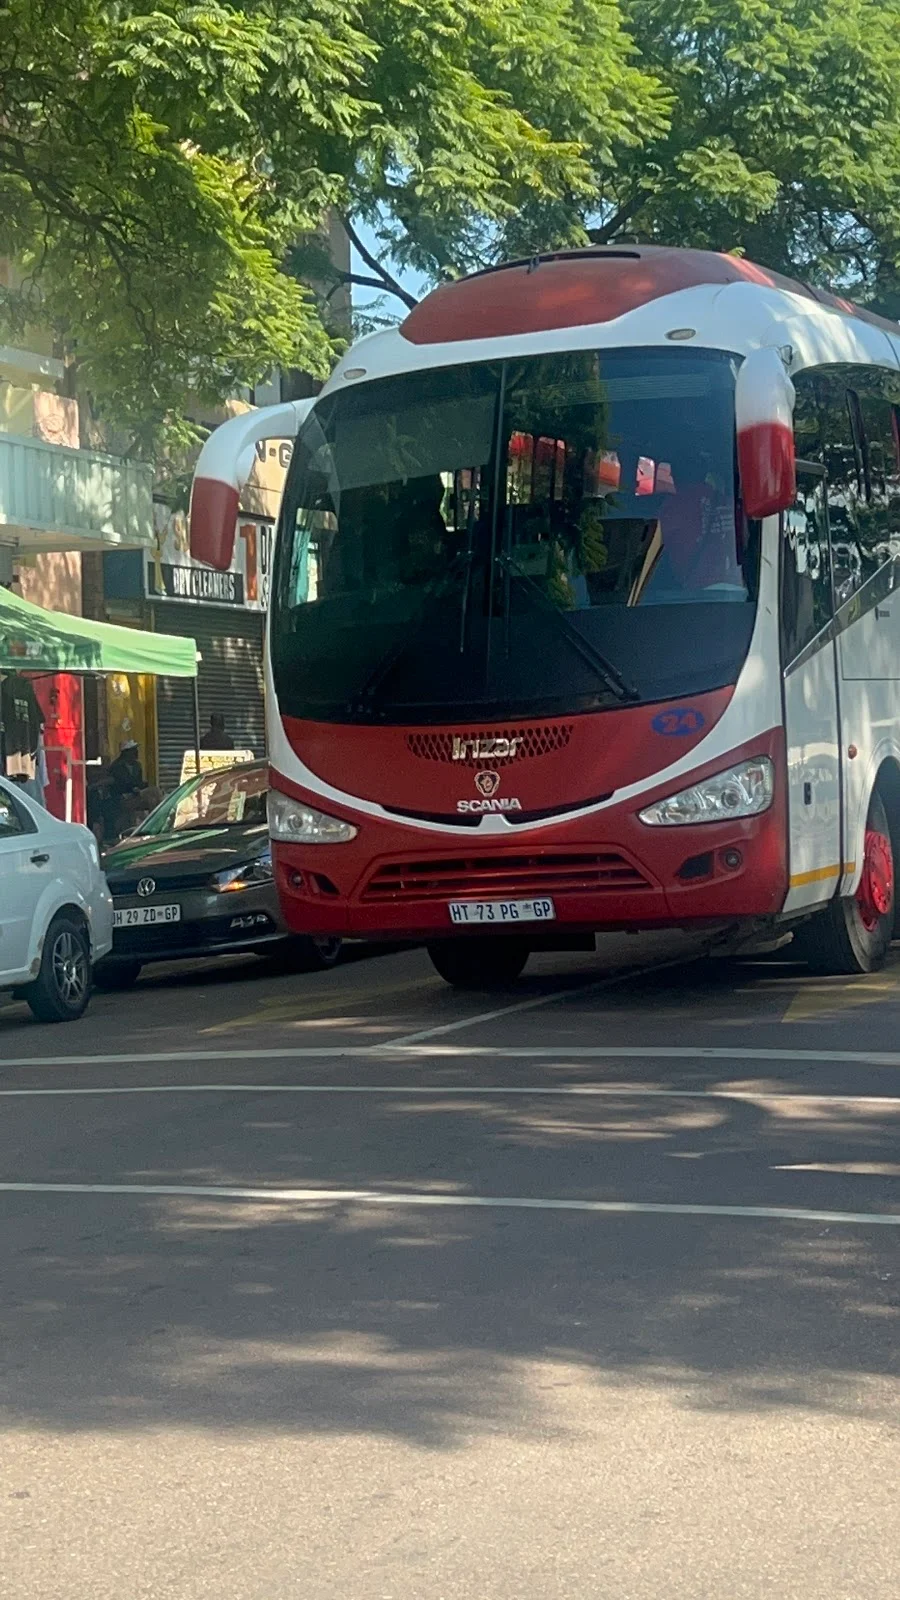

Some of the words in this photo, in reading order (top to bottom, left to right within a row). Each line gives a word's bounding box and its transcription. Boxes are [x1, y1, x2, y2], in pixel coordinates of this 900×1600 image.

[173, 567, 192, 596] DRY
[192, 569, 235, 601] CLEANERS
[456, 798, 522, 813] SCANIA
[126, 910, 139, 924] 29
[143, 908, 157, 922] ZD
[165, 907, 178, 920] GP
[451, 903, 469, 921] HT
[476, 904, 495, 921] 73
[500, 904, 519, 920] PG
[532, 901, 551, 917] GP
